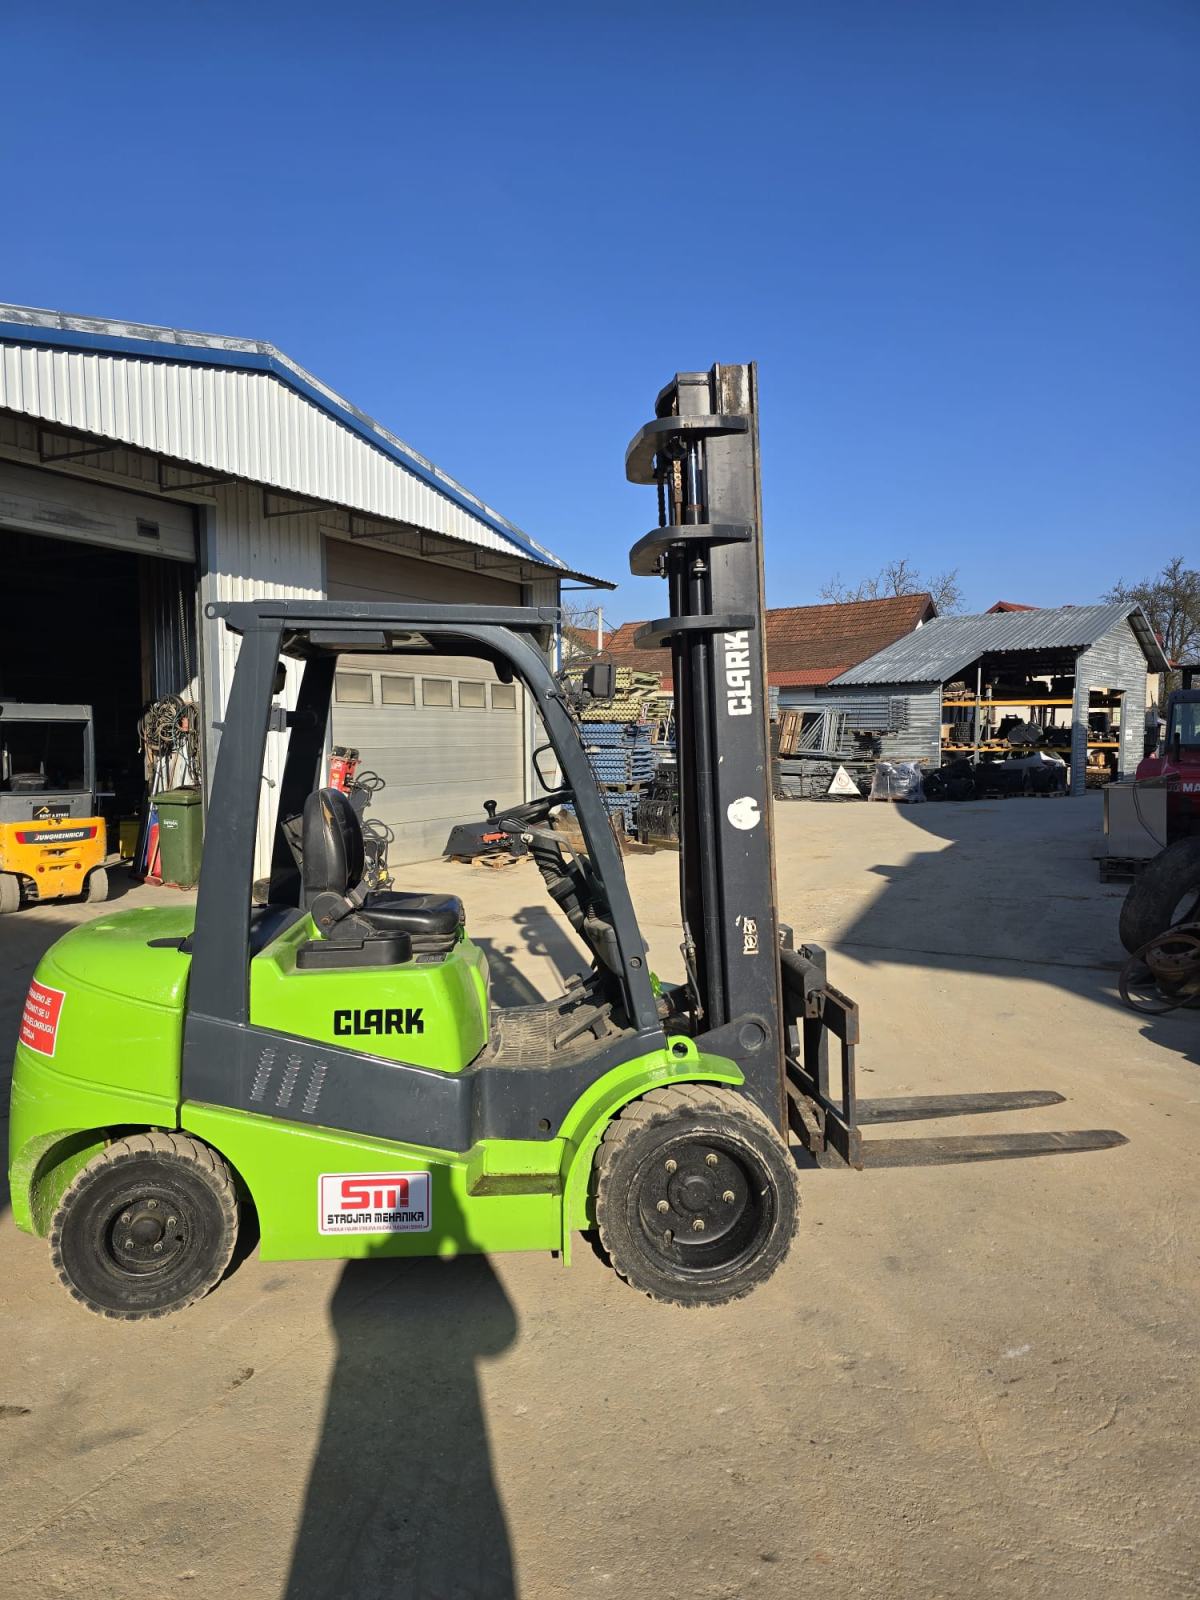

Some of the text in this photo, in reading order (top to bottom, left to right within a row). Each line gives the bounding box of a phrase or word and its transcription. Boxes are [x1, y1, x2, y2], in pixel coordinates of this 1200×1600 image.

[724, 630, 752, 716] CLARK
[34, 831, 84, 841] JUNGHEINRICH
[334, 1008, 424, 1035] CLARK
[327, 1211, 424, 1225] STROJNA MEHANIKA
